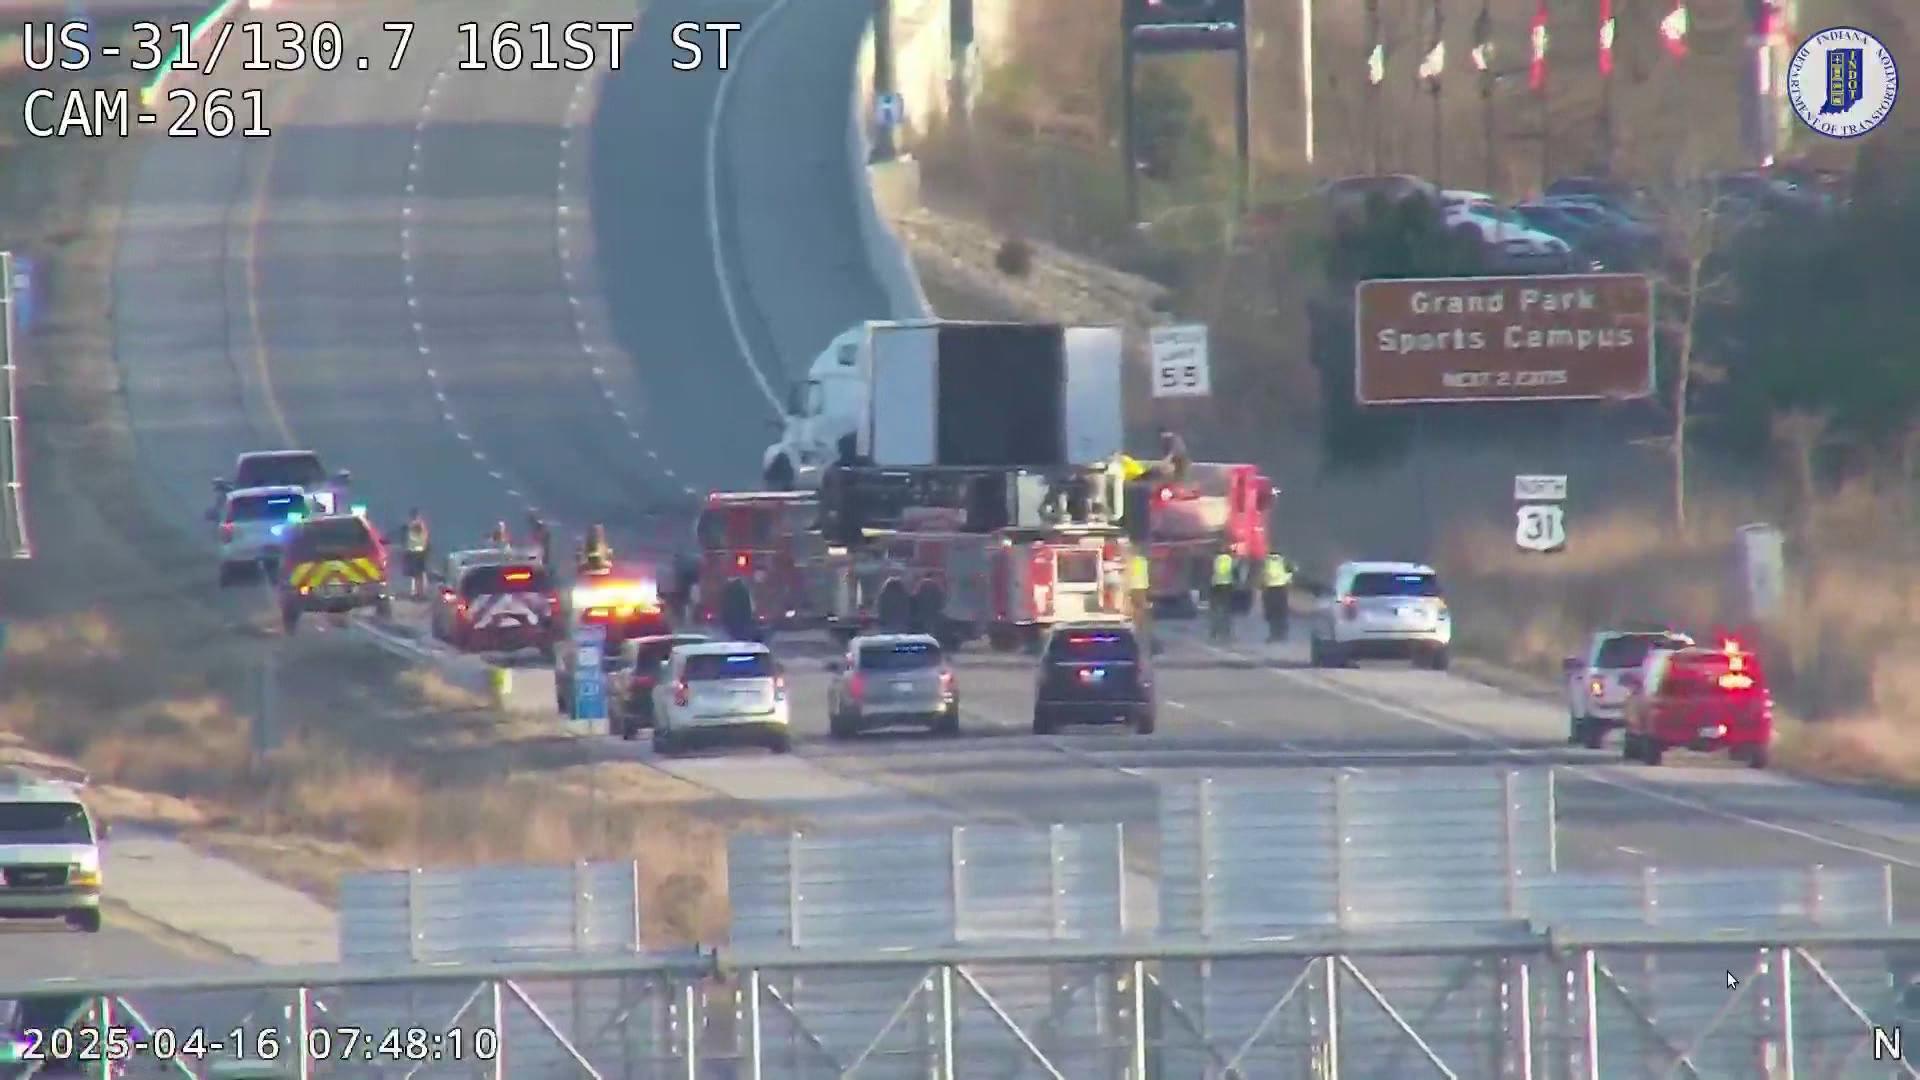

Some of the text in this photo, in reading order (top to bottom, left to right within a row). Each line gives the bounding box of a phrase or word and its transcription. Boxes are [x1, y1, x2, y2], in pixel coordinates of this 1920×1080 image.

[1410, 288, 1597, 314] Grand Park
[1376, 325, 1634, 355] Sports Campus
[1161, 366, 1196, 388] 55
[1526, 513, 1553, 540] 31
